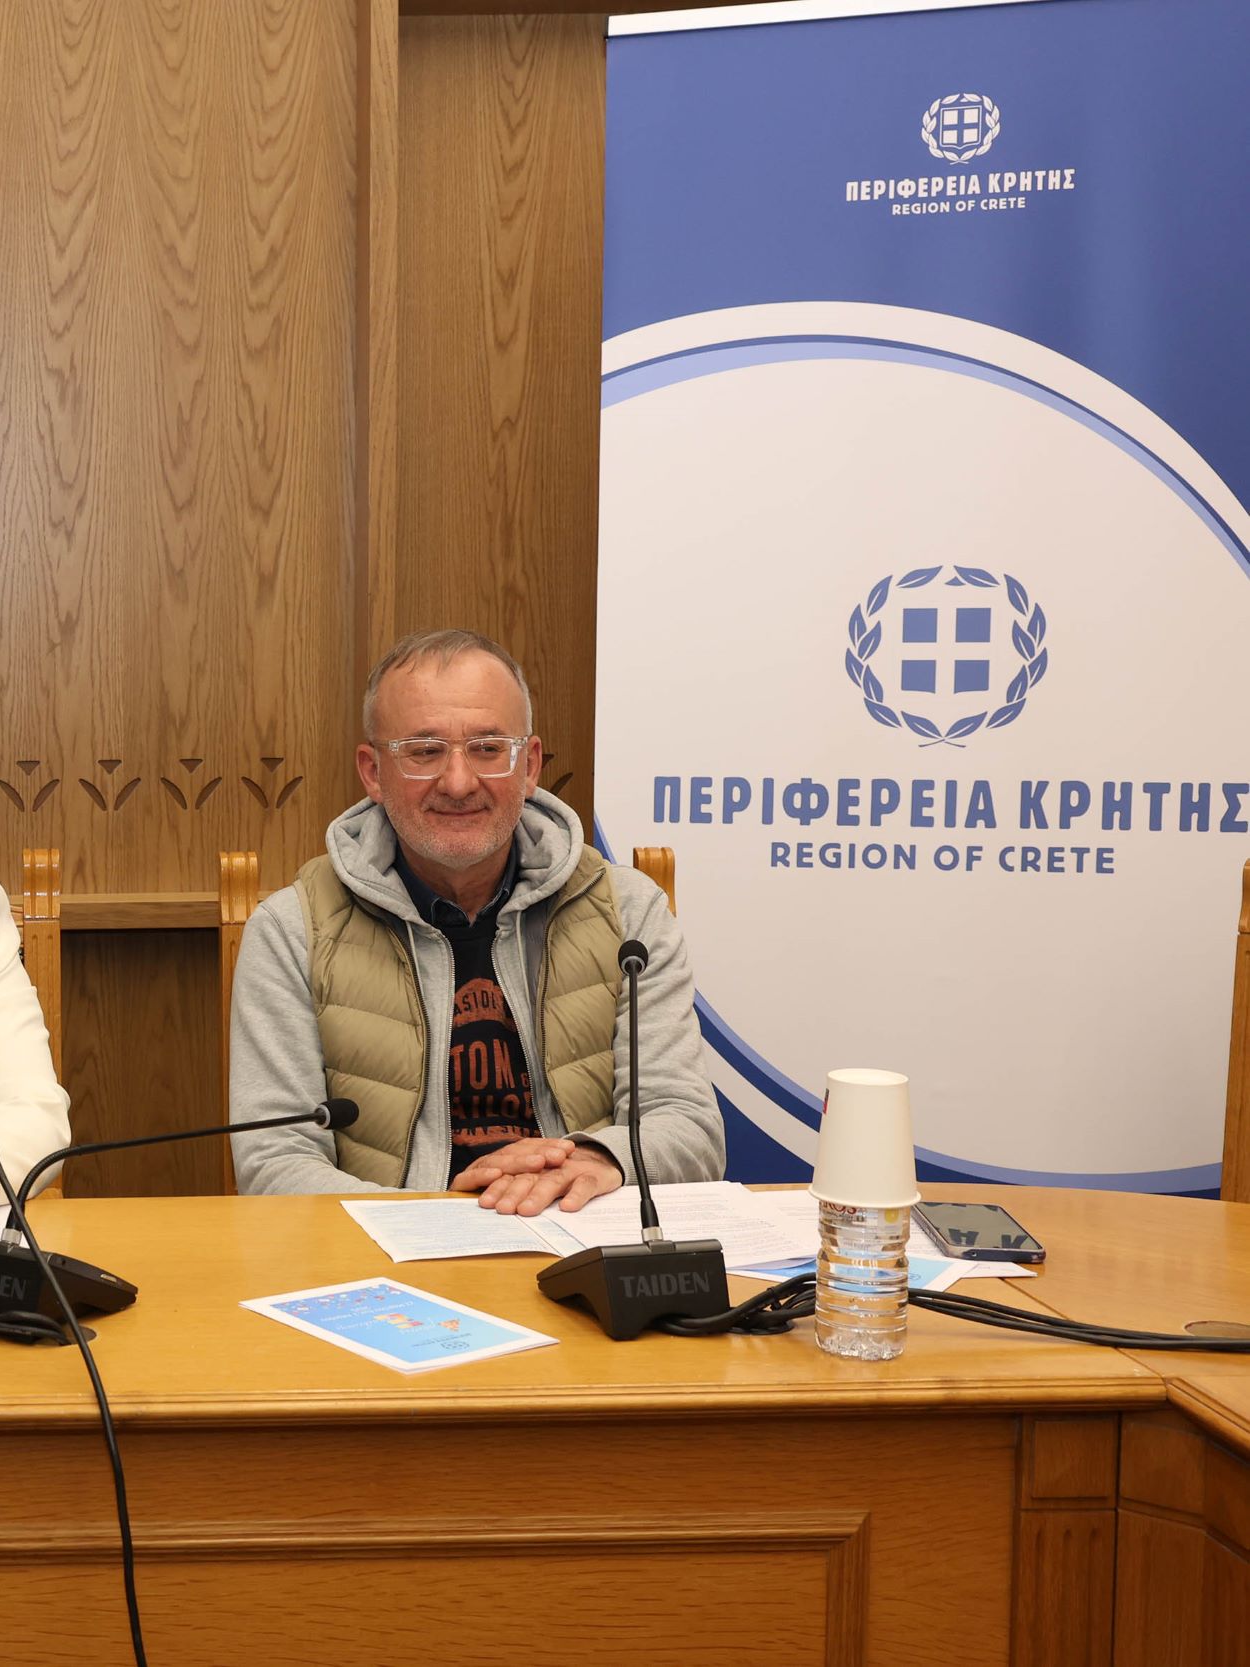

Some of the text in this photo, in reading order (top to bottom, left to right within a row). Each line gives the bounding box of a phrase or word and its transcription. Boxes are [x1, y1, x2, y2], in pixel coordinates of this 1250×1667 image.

[846, 169, 1075, 201] ΠΕΡΙΦΕΡΕΙΑ ΚΡΗΤΗΣ
[892, 197, 1026, 215] REGION OF CRETE
[653, 776, 1250, 833] ΠΕΡΙΦΕΡΕΙΑ ΚΡΗΤΗΣ
[770, 842, 1116, 874] REGION OF CRETE
[450, 1038, 516, 1092] TOM
[619, 1271, 711, 1298] TAIDEN
